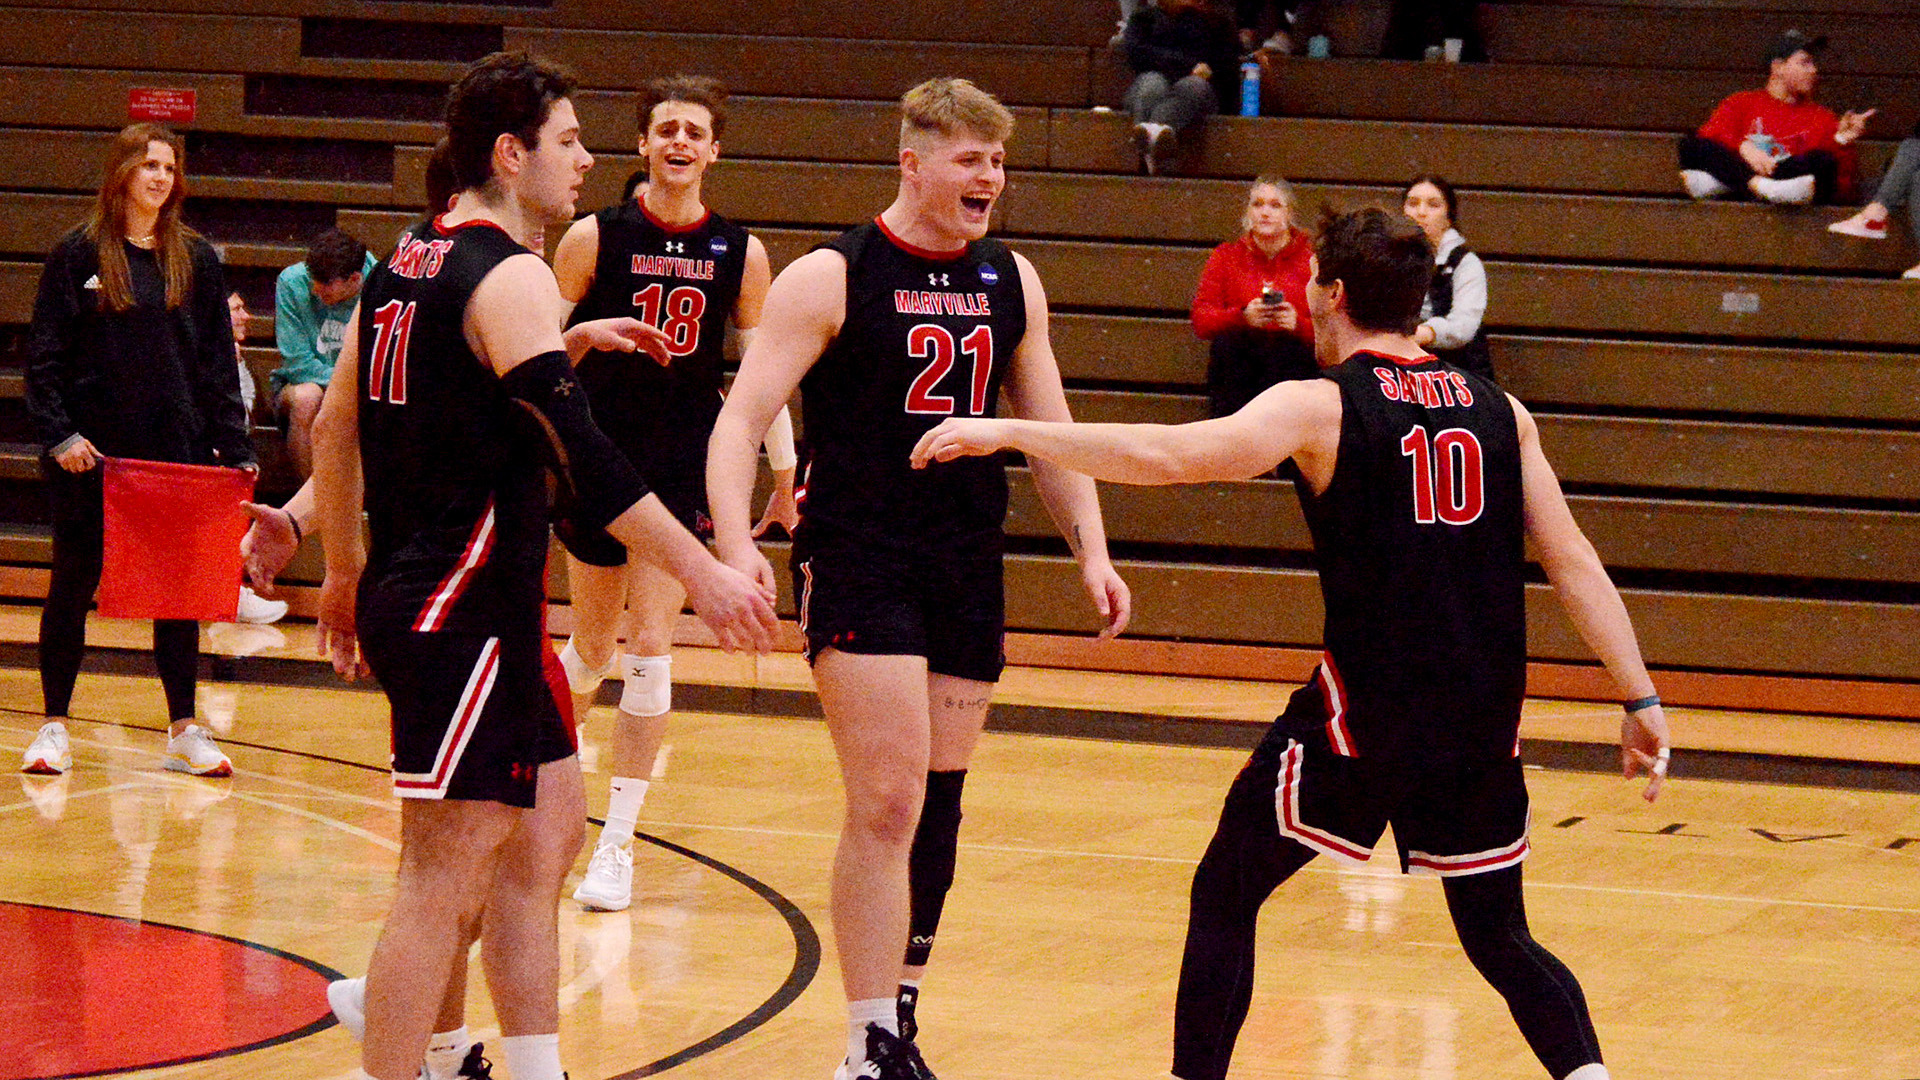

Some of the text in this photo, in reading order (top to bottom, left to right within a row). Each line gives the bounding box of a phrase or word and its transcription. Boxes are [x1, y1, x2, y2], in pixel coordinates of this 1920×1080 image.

[631, 254, 715, 280] MARYVILLE
[894, 289, 991, 316] MARYVILLE
[369, 299, 417, 405] 11
[632, 283, 706, 356] 18
[905, 323, 993, 415] 21
[1401, 424, 1484, 526] 10
